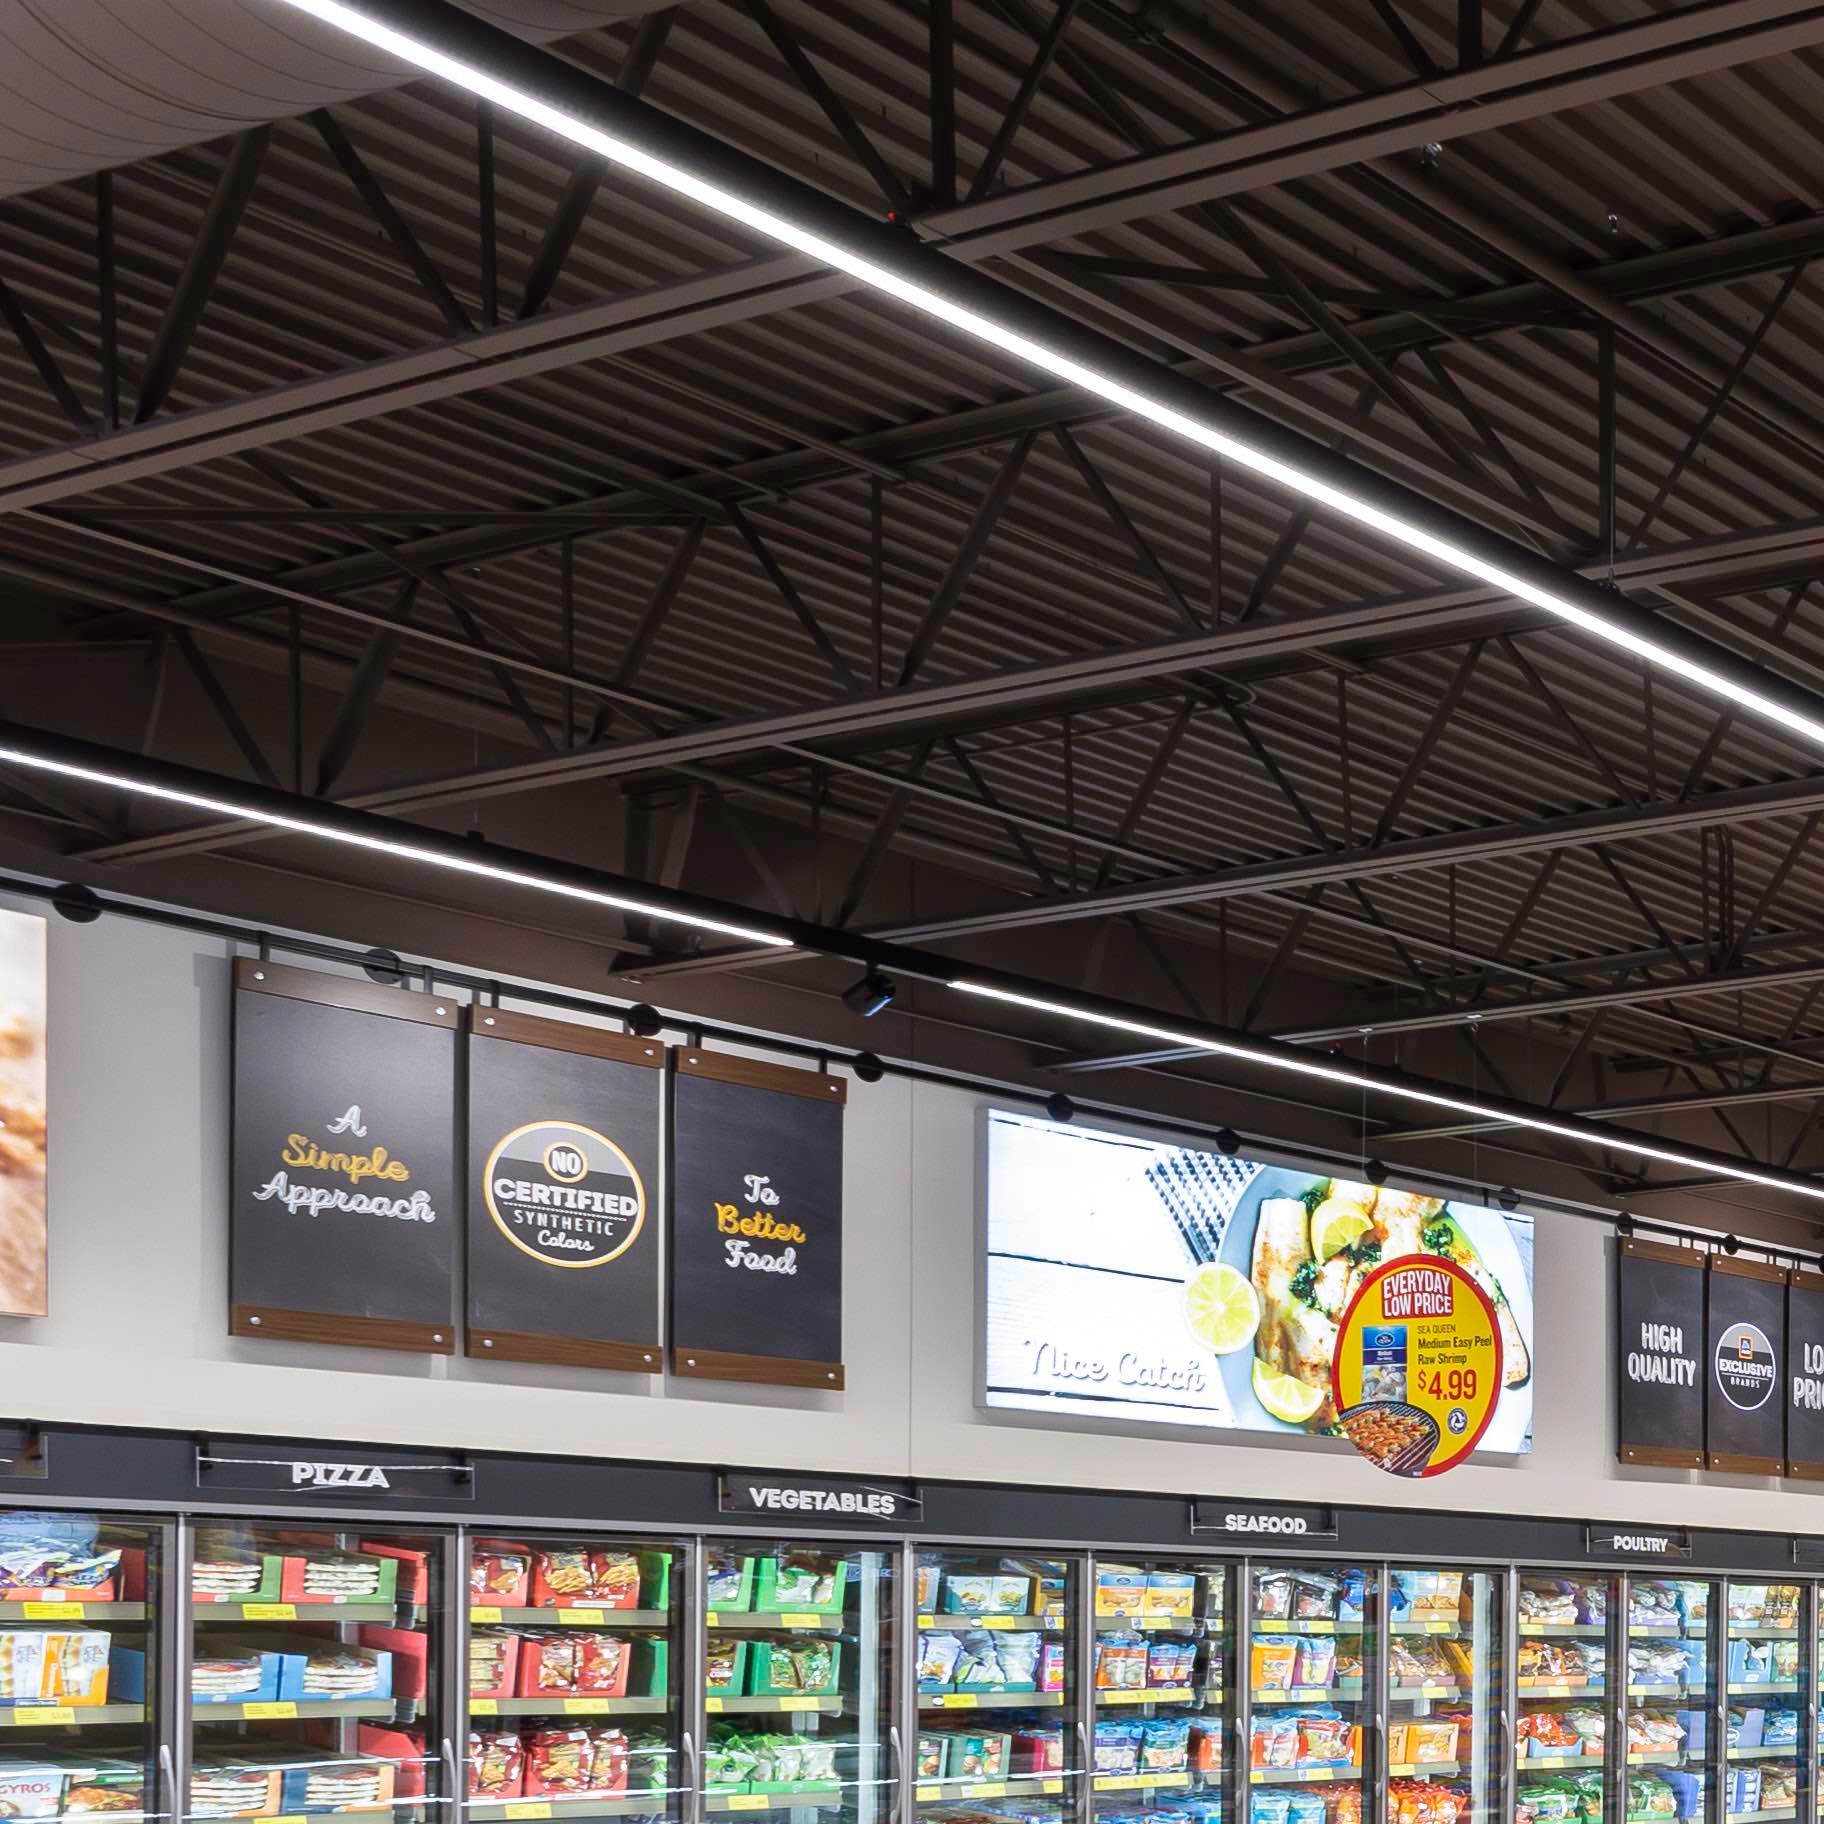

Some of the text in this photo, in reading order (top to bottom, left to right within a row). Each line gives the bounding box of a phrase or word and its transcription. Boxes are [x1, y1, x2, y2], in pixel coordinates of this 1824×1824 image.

[327, 1105, 367, 1137] A
[282, 1133, 410, 1184] Simple
[551, 1150, 580, 1174] NO
[253, 1171, 436, 1223] Approach
[494, 1178, 639, 1217] CERTIFIED
[743, 1173, 780, 1207] To
[513, 1209, 614, 1236] SYNTHETIC
[714, 1202, 806, 1245] Better
[537, 1230, 595, 1252] Colors
[725, 1237, 797, 1277] Food
[1384, 1270, 1451, 1300] EVERYDAY
[1384, 1295, 1452, 1317] LOW PRICE
[1417, 1324, 1457, 1334] SEA QUEEN
[1418, 1334, 1492, 1350] Medium Easy Peel
[1640, 1322, 1683, 1354] HIGH
[1022, 1337, 1207, 1393] Nice Catch
[1418, 1353, 1467, 1366] Raw Shrimp
[1627, 1353, 1697, 1387] QUALITY
[1719, 1358, 1773, 1378] EXCLUSIVE
[1417, 1369, 1478, 1401] $4.99
[1730, 1376, 1760, 1389] BRANDS
[290, 1462, 390, 1489] PIZZA
[749, 1486, 895, 1515] VEGETABLES
[1225, 1513, 1307, 1536] SEAFOOD
[1612, 1535, 1668, 1554] POULTRY
